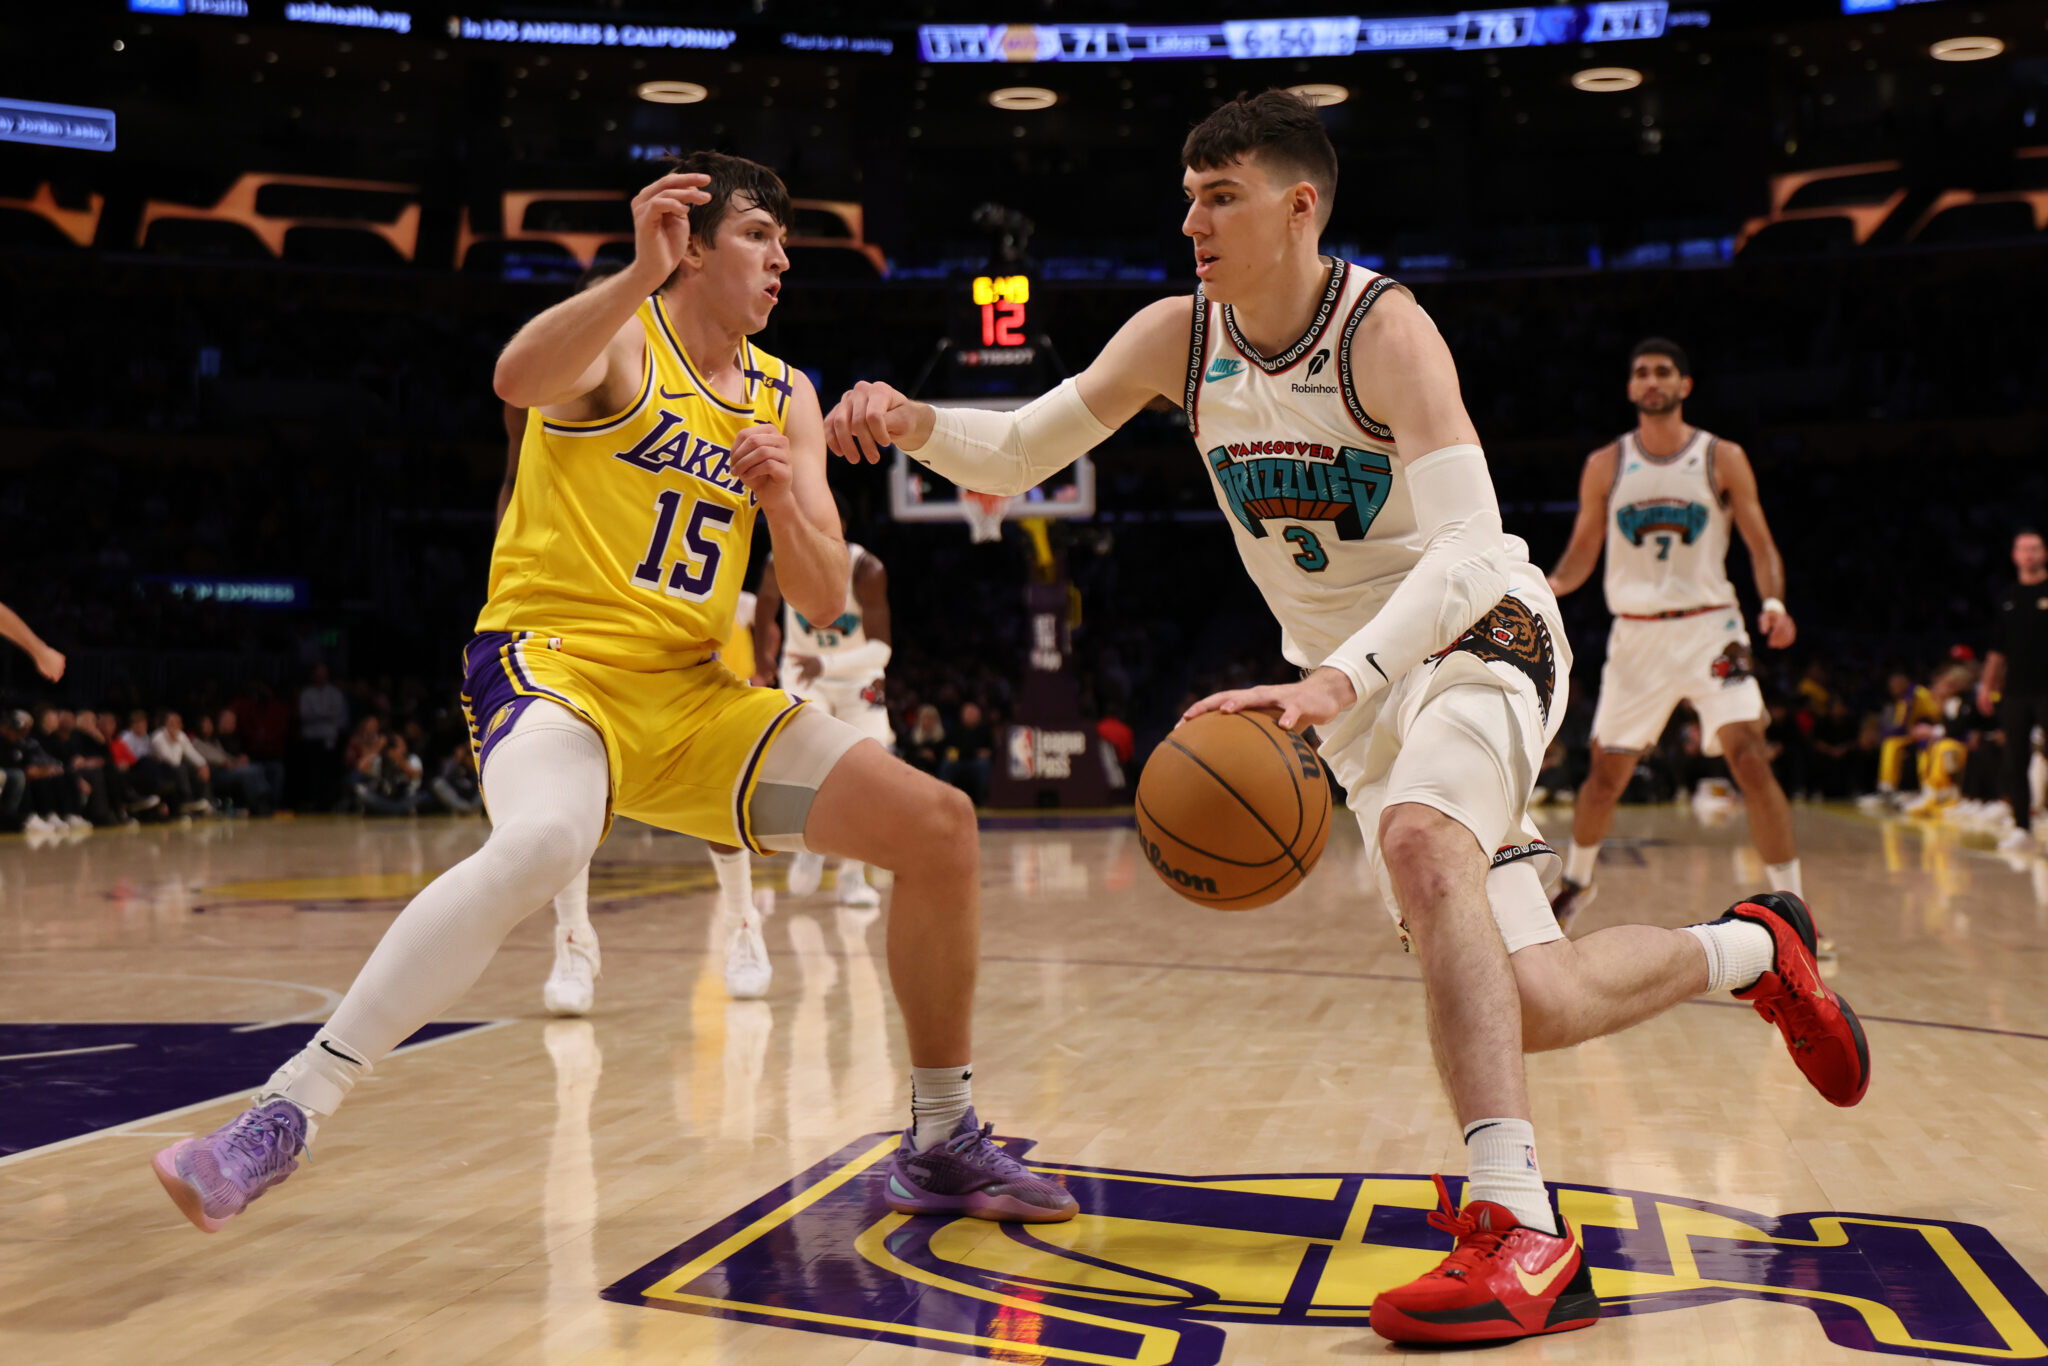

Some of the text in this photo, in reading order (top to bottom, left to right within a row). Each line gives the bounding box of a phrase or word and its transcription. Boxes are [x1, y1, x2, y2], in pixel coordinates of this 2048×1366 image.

[481, 19, 520, 42] LOS
[519, 21, 602, 45] ANGELES
[981, 299, 1027, 347] 12
[1211, 357, 1241, 374] NIKE
[612, 408, 759, 508] LAKE
[1228, 440, 1335, 461] VANCOUVER
[1207, 444, 1393, 541] GRIZZLIES
[631, 487, 737, 604] 15
[1282, 525, 1330, 573] 3
[1655, 535, 1673, 561] 7
